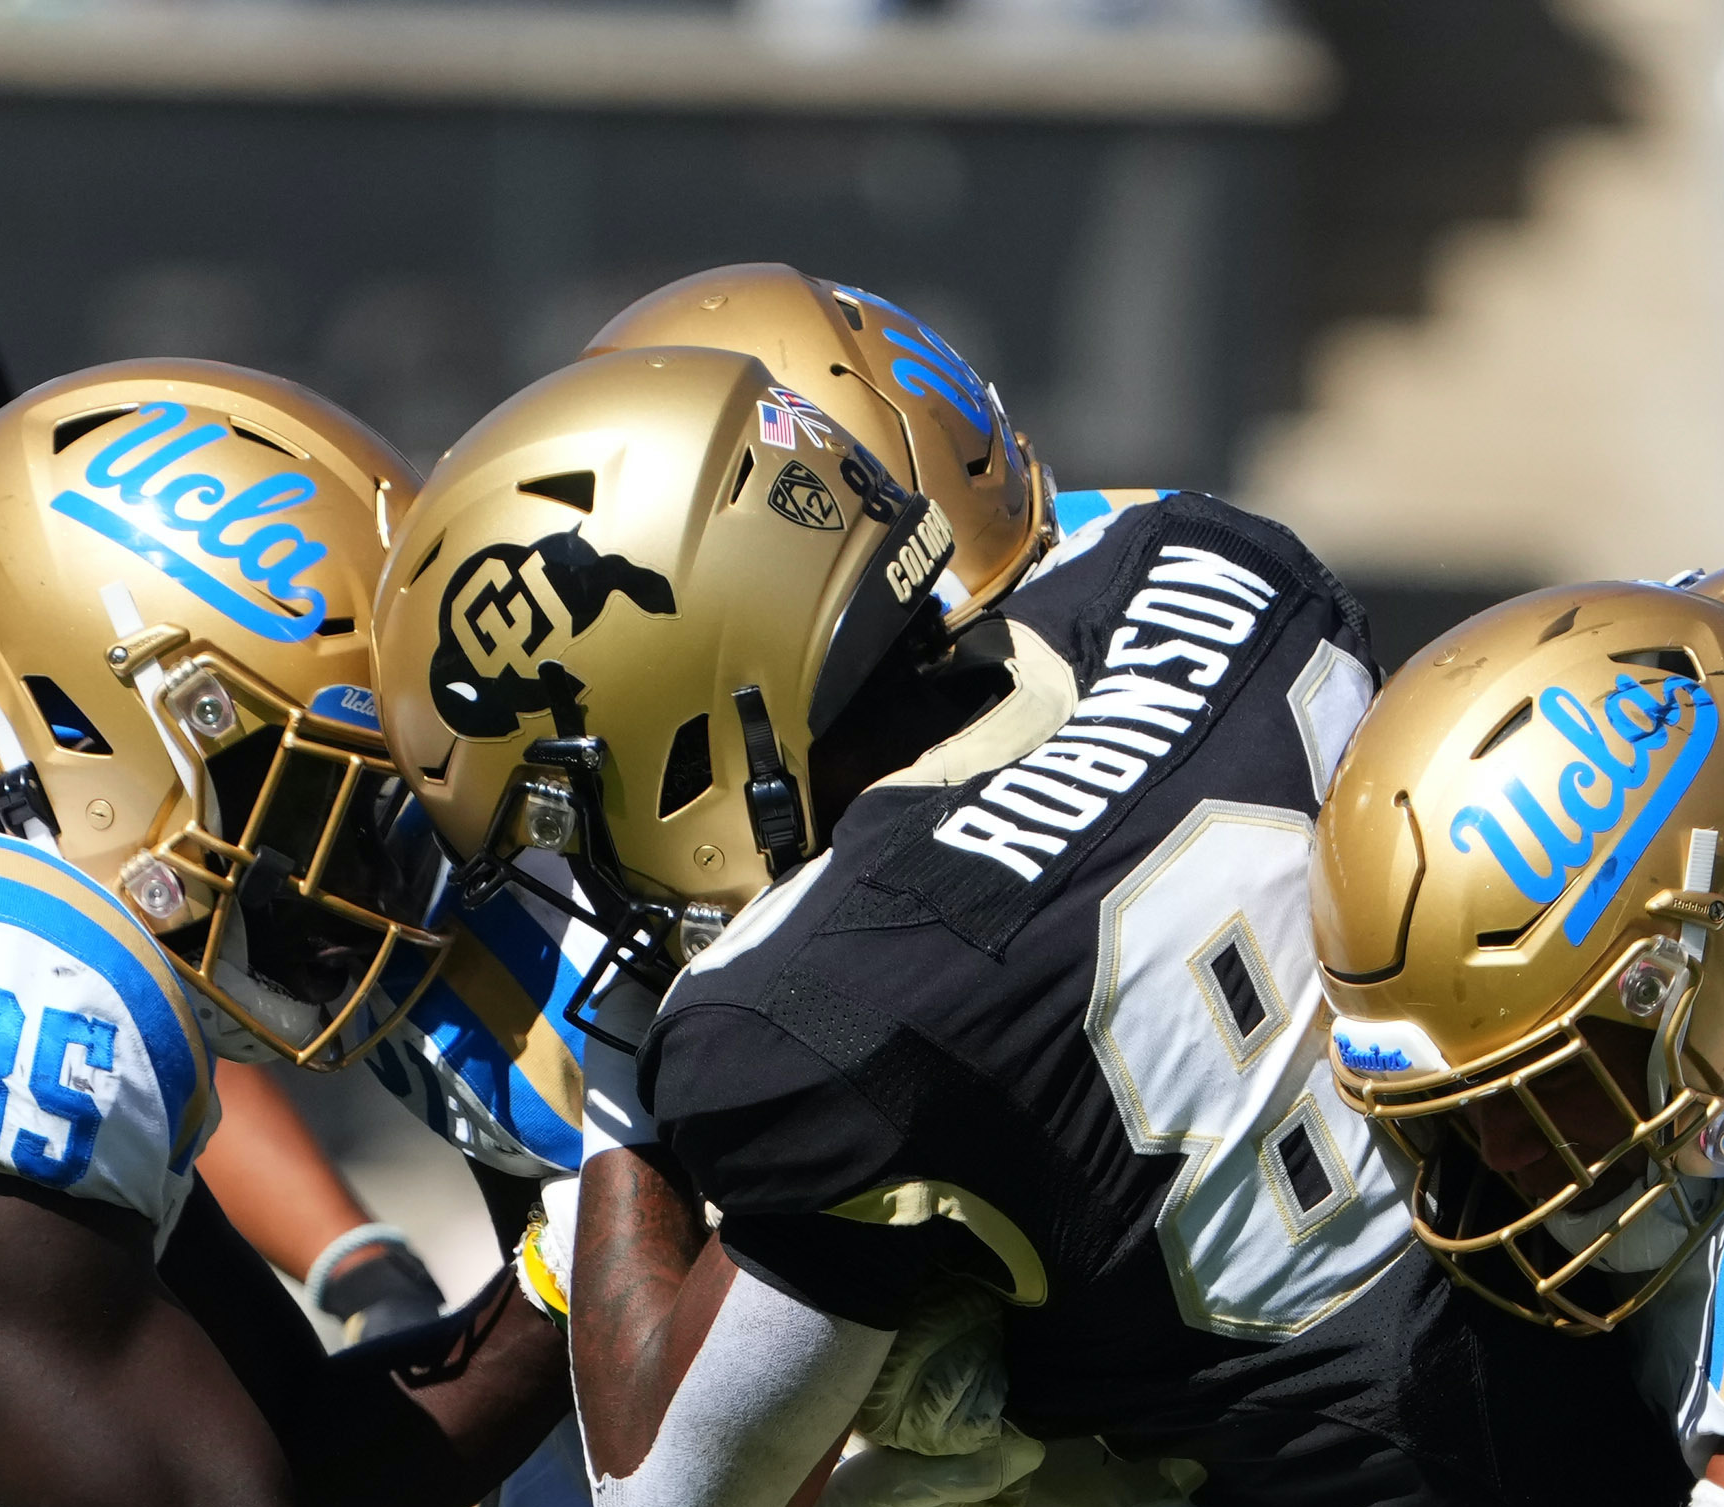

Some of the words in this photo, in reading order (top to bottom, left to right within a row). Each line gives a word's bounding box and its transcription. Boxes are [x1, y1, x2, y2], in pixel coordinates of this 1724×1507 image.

[50, 400, 327, 643] Ucla
[773, 464, 825, 523] PAC
[802, 489, 834, 526] 12
[934, 544, 1279, 883] ROBINSON
[1449, 673, 1720, 948] Ucla
[1084, 637, 1418, 1343] 8
